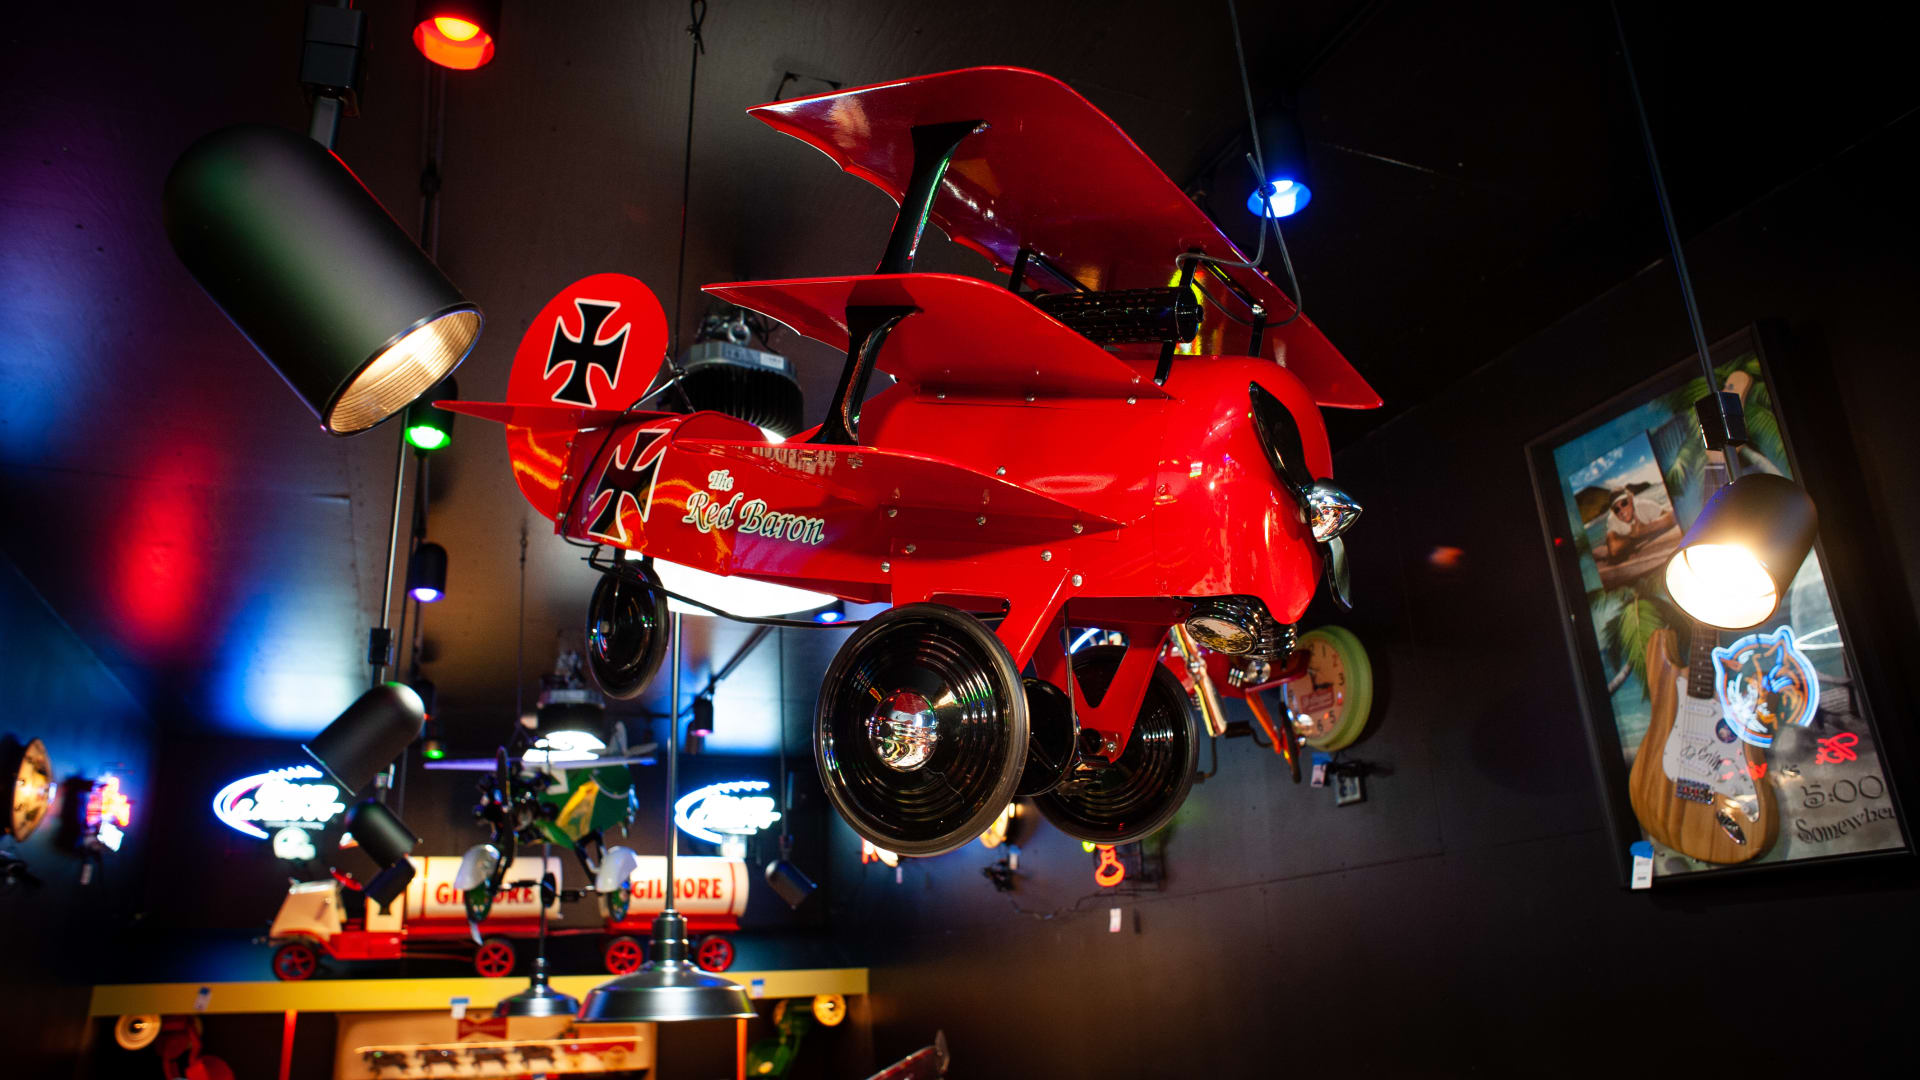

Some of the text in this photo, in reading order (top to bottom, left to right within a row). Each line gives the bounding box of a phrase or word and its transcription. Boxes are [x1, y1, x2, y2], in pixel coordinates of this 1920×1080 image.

[708, 469, 734, 492] The
[682, 490, 825, 545] Red Baron
[1801, 775, 1885, 809] 5:00
